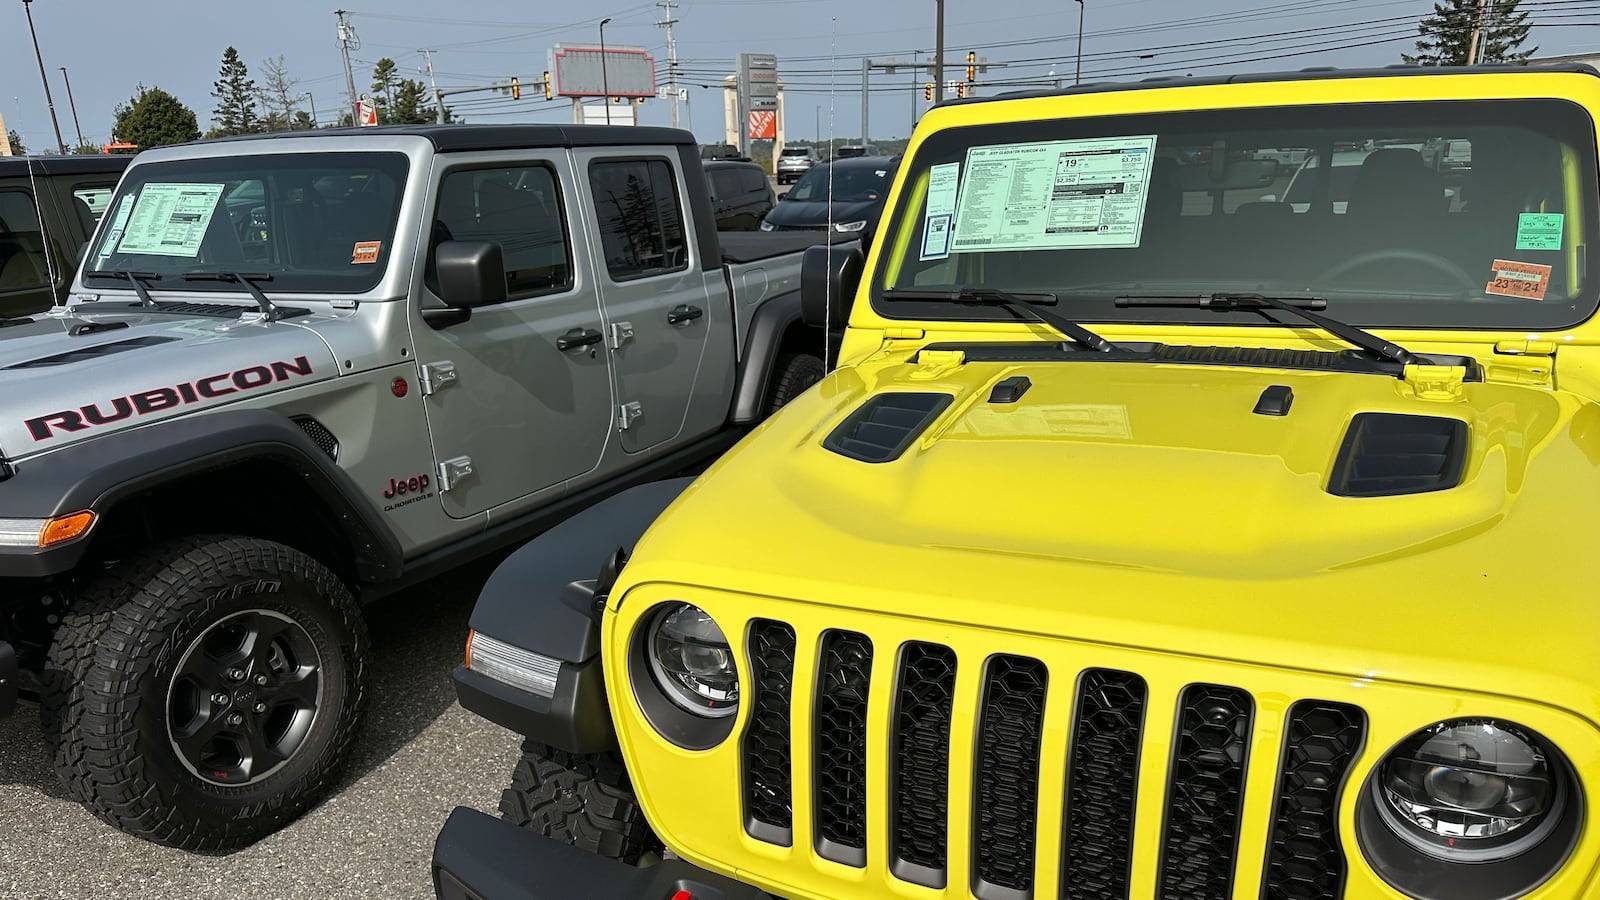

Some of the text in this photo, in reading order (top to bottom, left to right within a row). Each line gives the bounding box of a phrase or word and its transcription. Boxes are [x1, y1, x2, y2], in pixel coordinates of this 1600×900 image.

[1065, 159, 1077, 167] 19
[1495, 278, 1509, 288] 23
[1523, 282, 1539, 292] 24
[25, 355, 313, 442] RUBICON
[383, 474, 429, 503] Jeep
